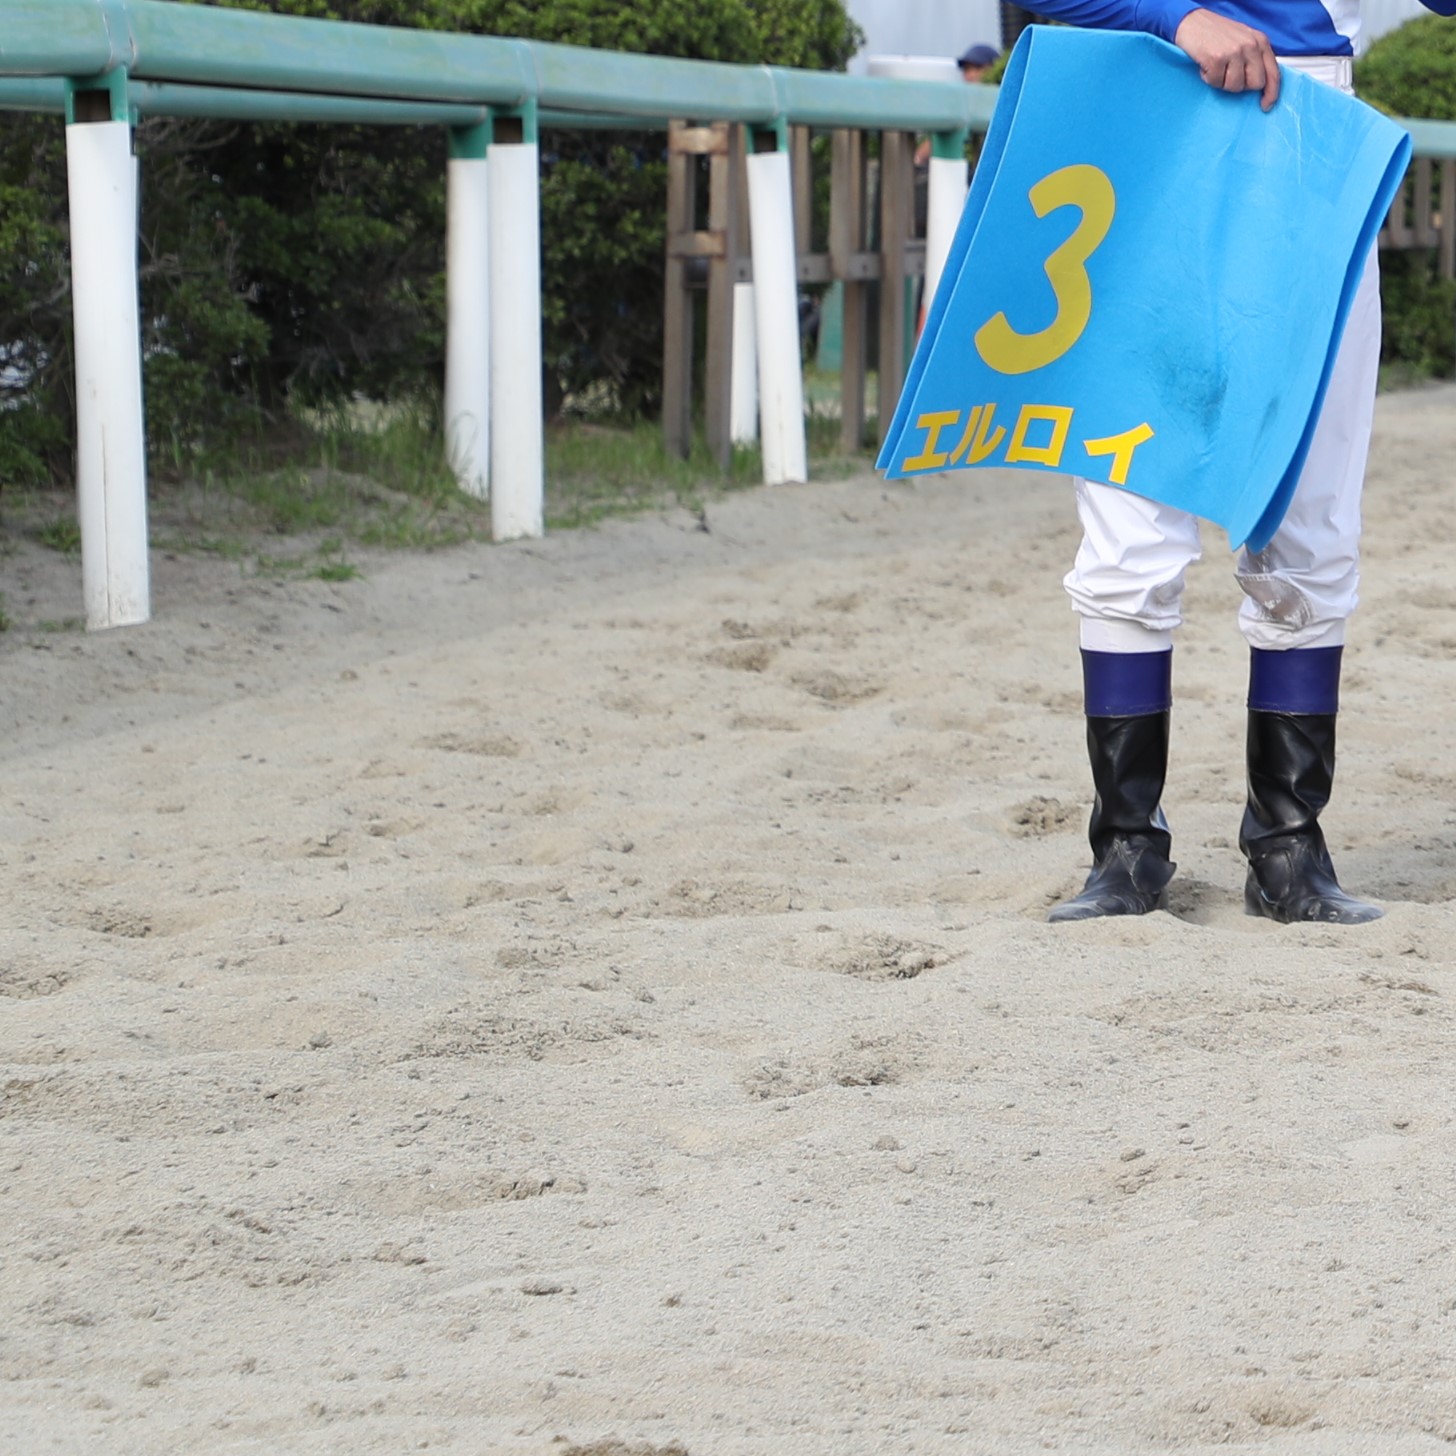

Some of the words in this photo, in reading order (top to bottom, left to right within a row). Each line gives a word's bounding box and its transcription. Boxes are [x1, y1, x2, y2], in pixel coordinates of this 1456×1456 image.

[974, 164, 1116, 375] 3
[901, 402, 1155, 485] エルロイ
